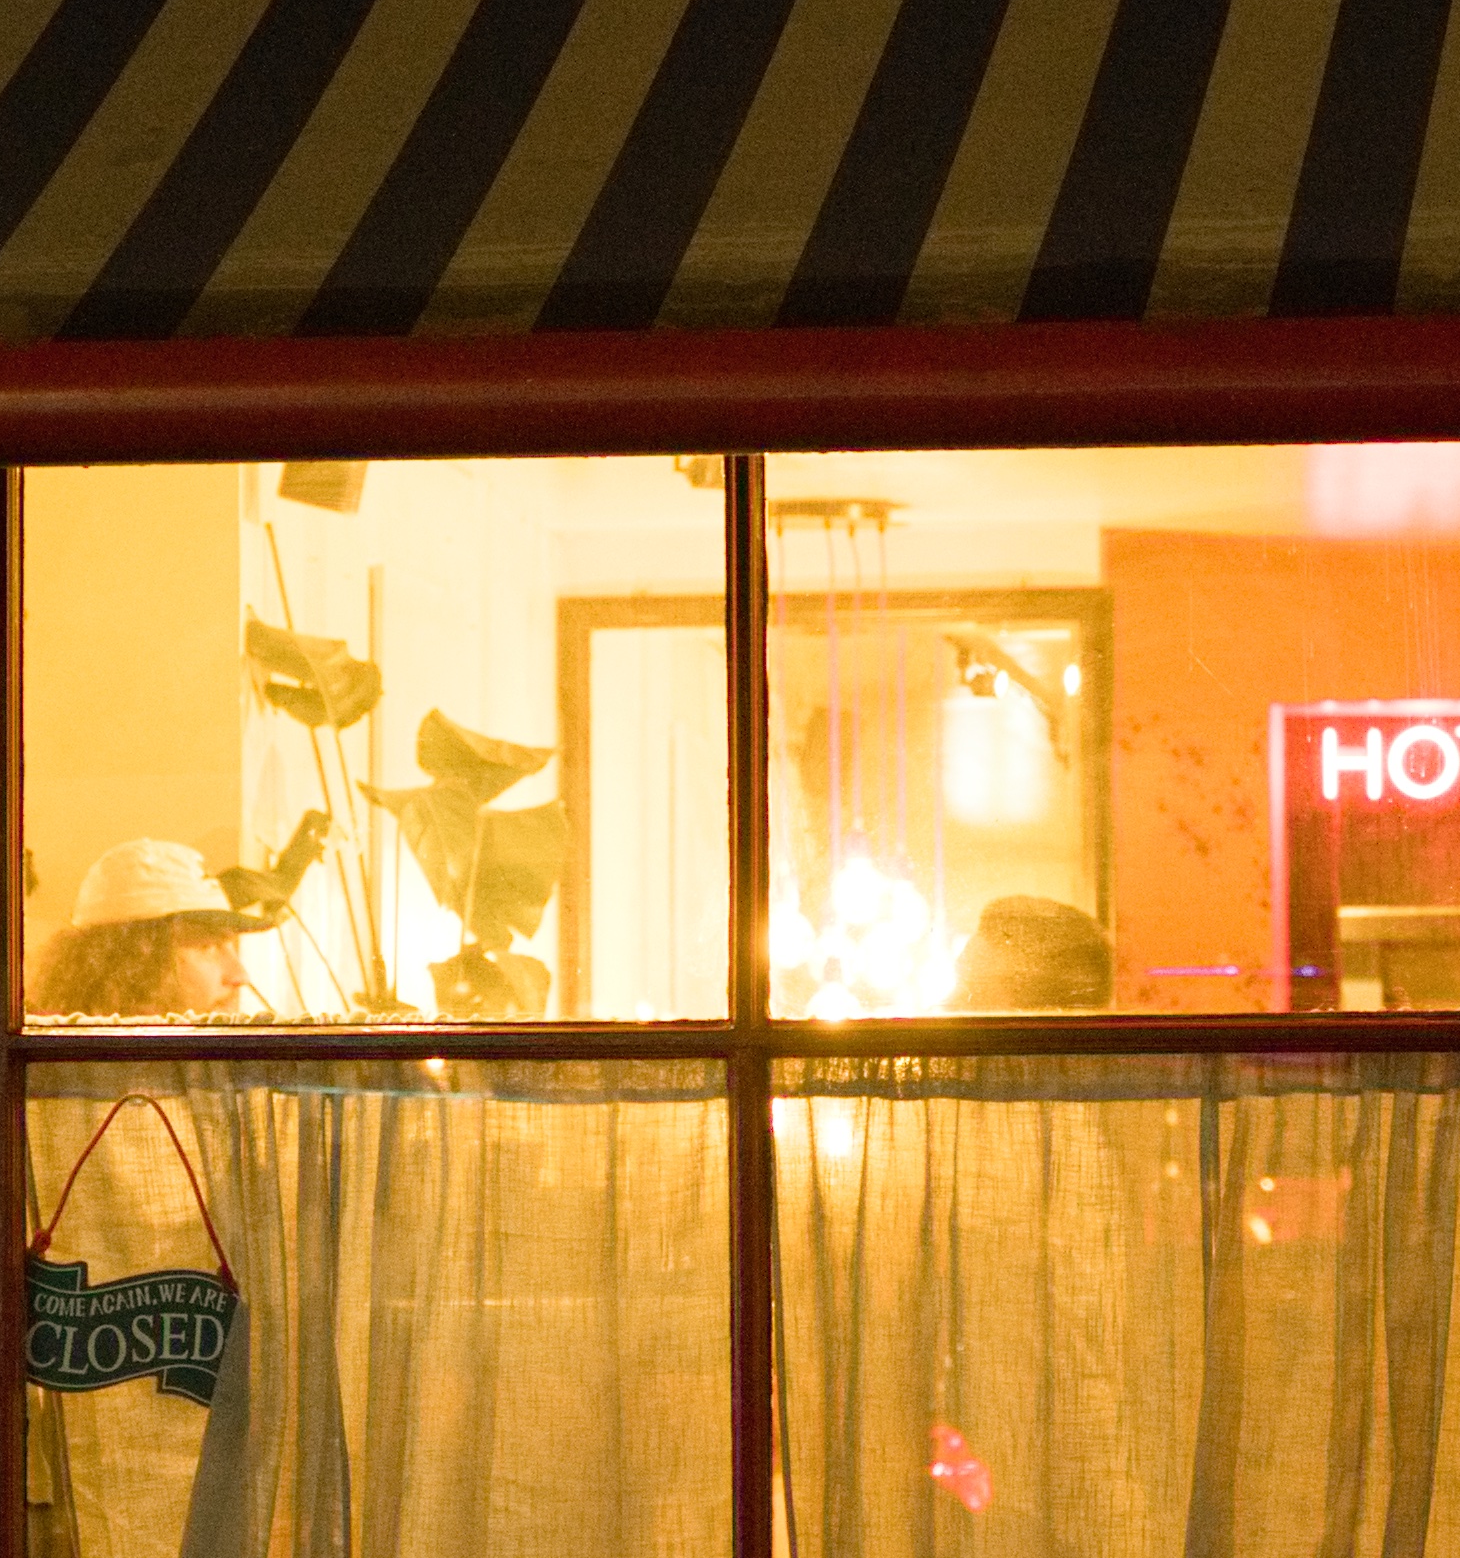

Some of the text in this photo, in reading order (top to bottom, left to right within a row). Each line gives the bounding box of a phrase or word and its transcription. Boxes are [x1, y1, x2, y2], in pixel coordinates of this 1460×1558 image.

[33, 1292, 86, 1318] COME
[158, 1283, 186, 1304] WE
[188, 1284, 227, 1313] ARE
[27, 1312, 226, 1375] CLOSED
